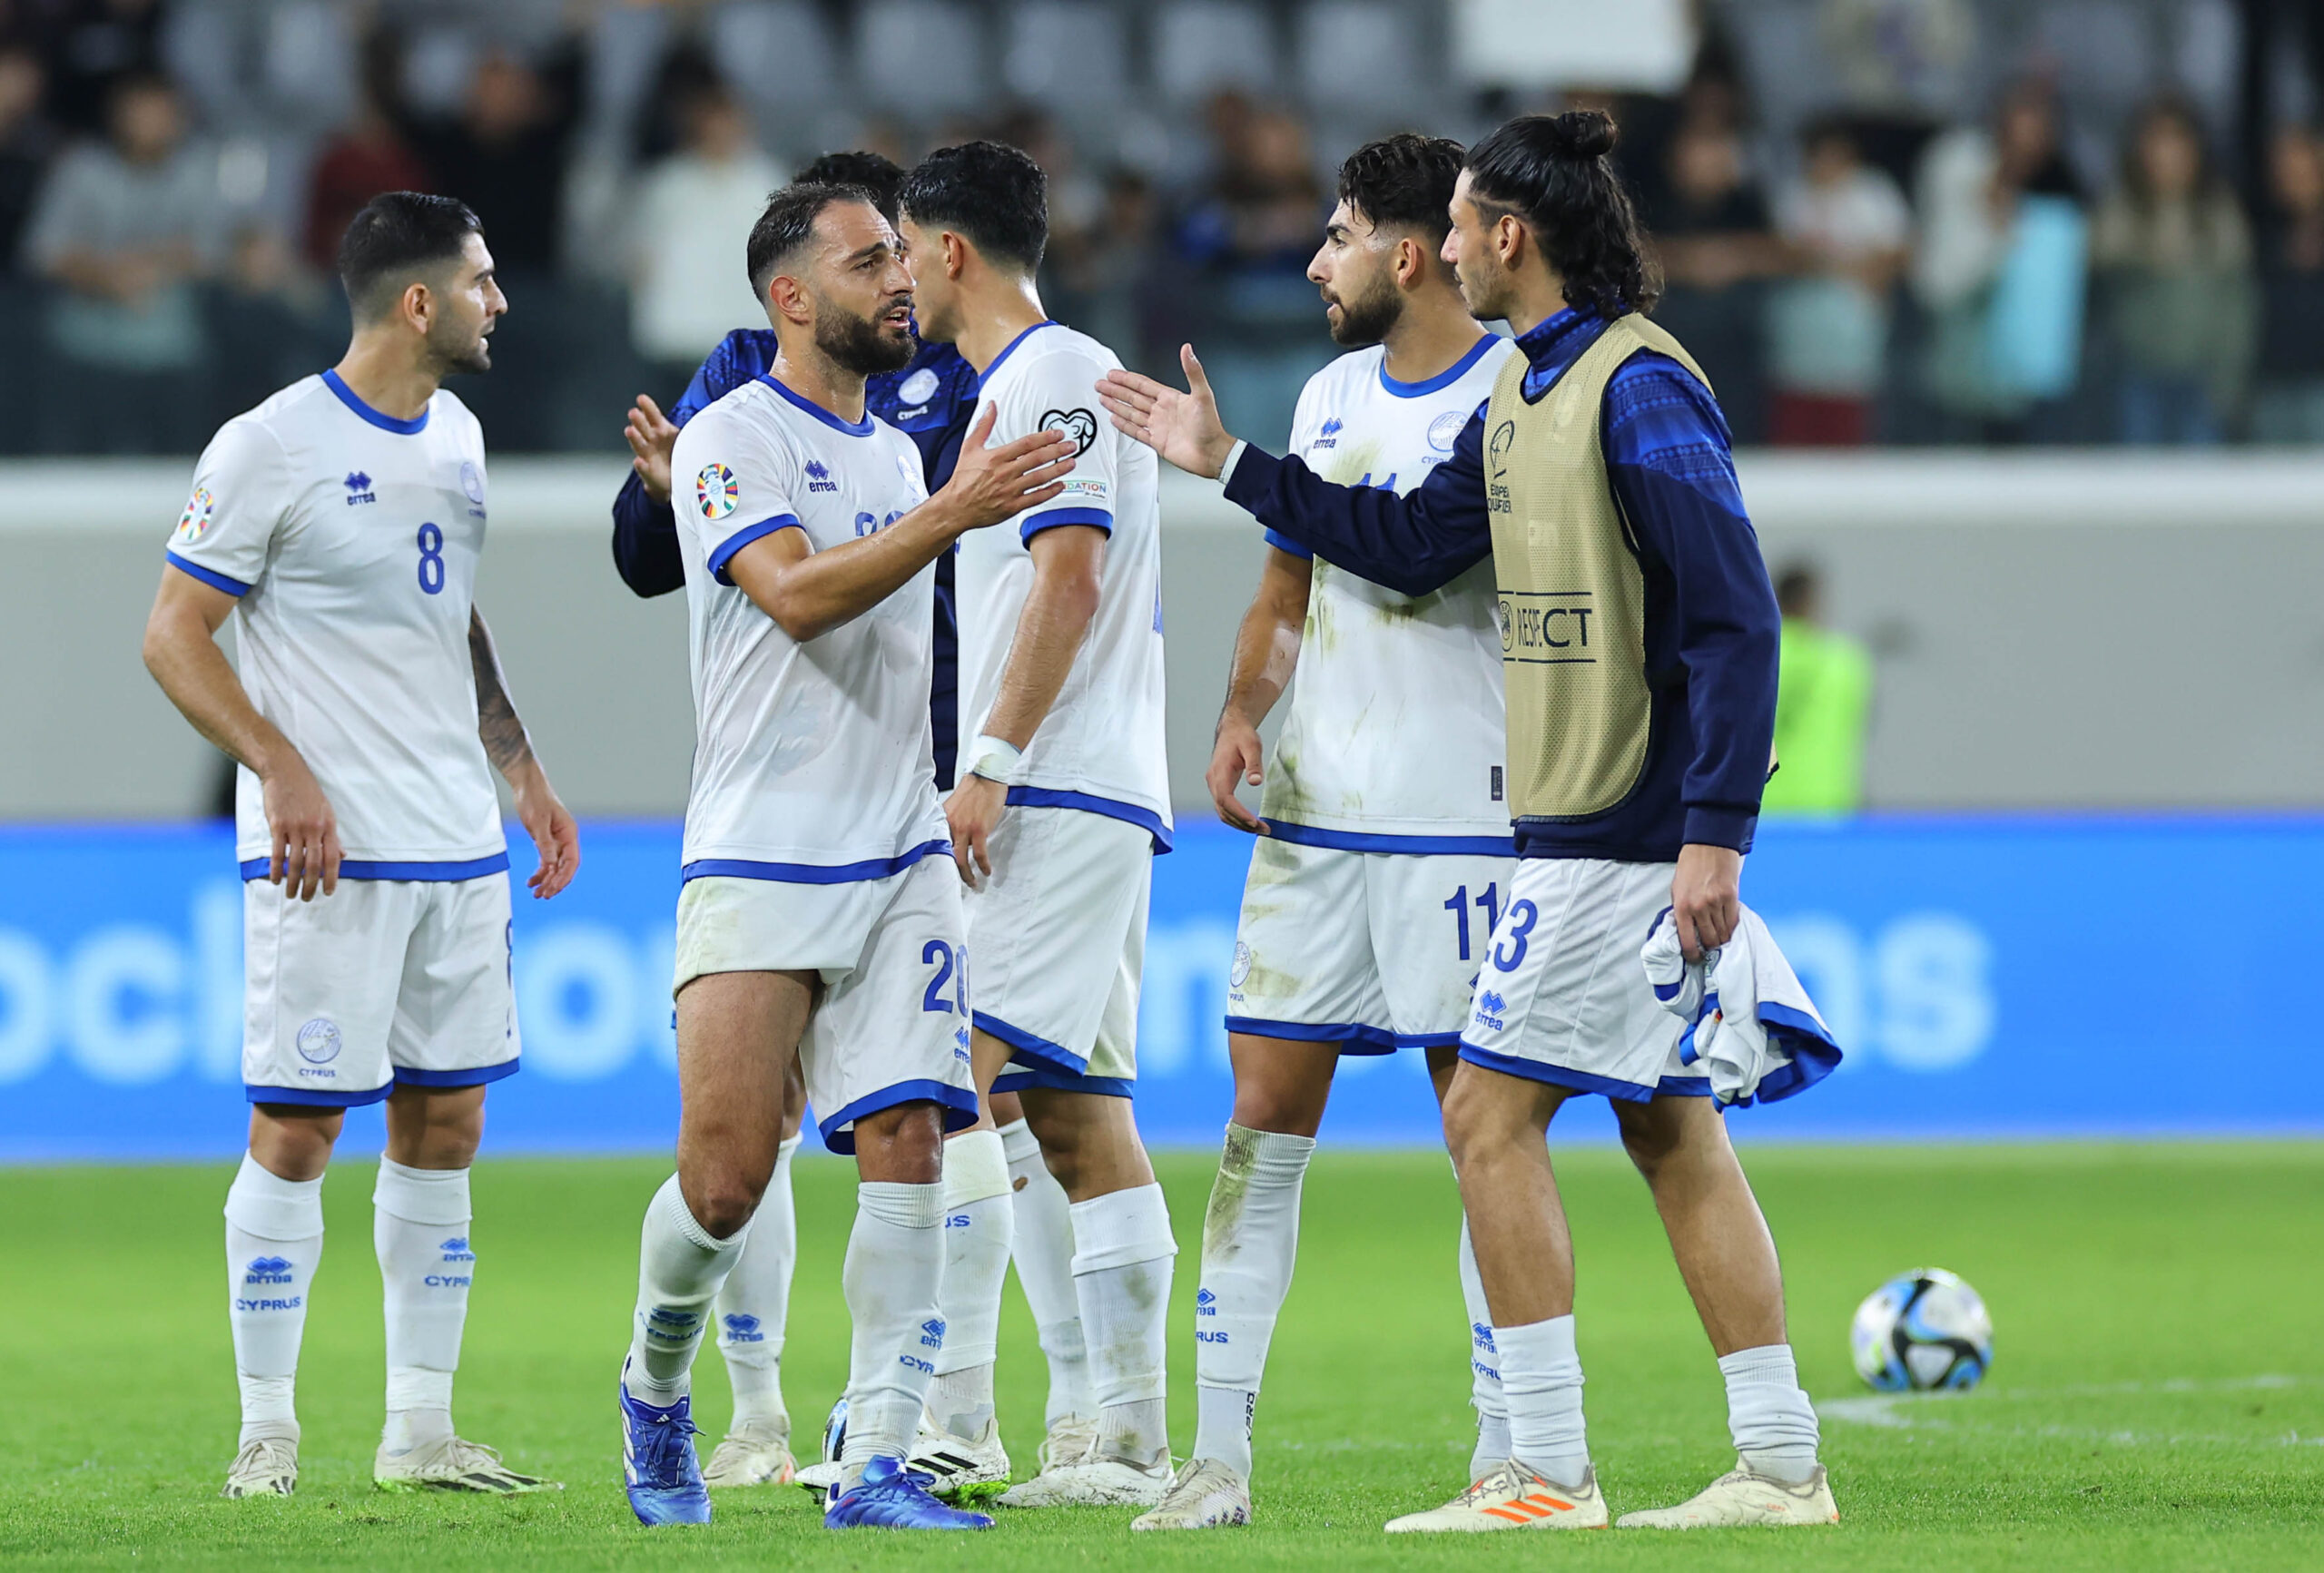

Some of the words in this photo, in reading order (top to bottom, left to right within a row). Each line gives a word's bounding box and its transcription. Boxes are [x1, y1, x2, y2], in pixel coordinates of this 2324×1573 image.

[1066, 482, 1107, 494] DATION
[417, 522, 445, 595] 8
[1444, 882, 1498, 960] 11
[1484, 890, 1538, 973] 3
[922, 939, 970, 1018] 20
[299, 1067, 336, 1077] CYPRUS
[236, 1296, 300, 1311] CYPRUS
[1196, 1331, 1228, 1343] RUS
